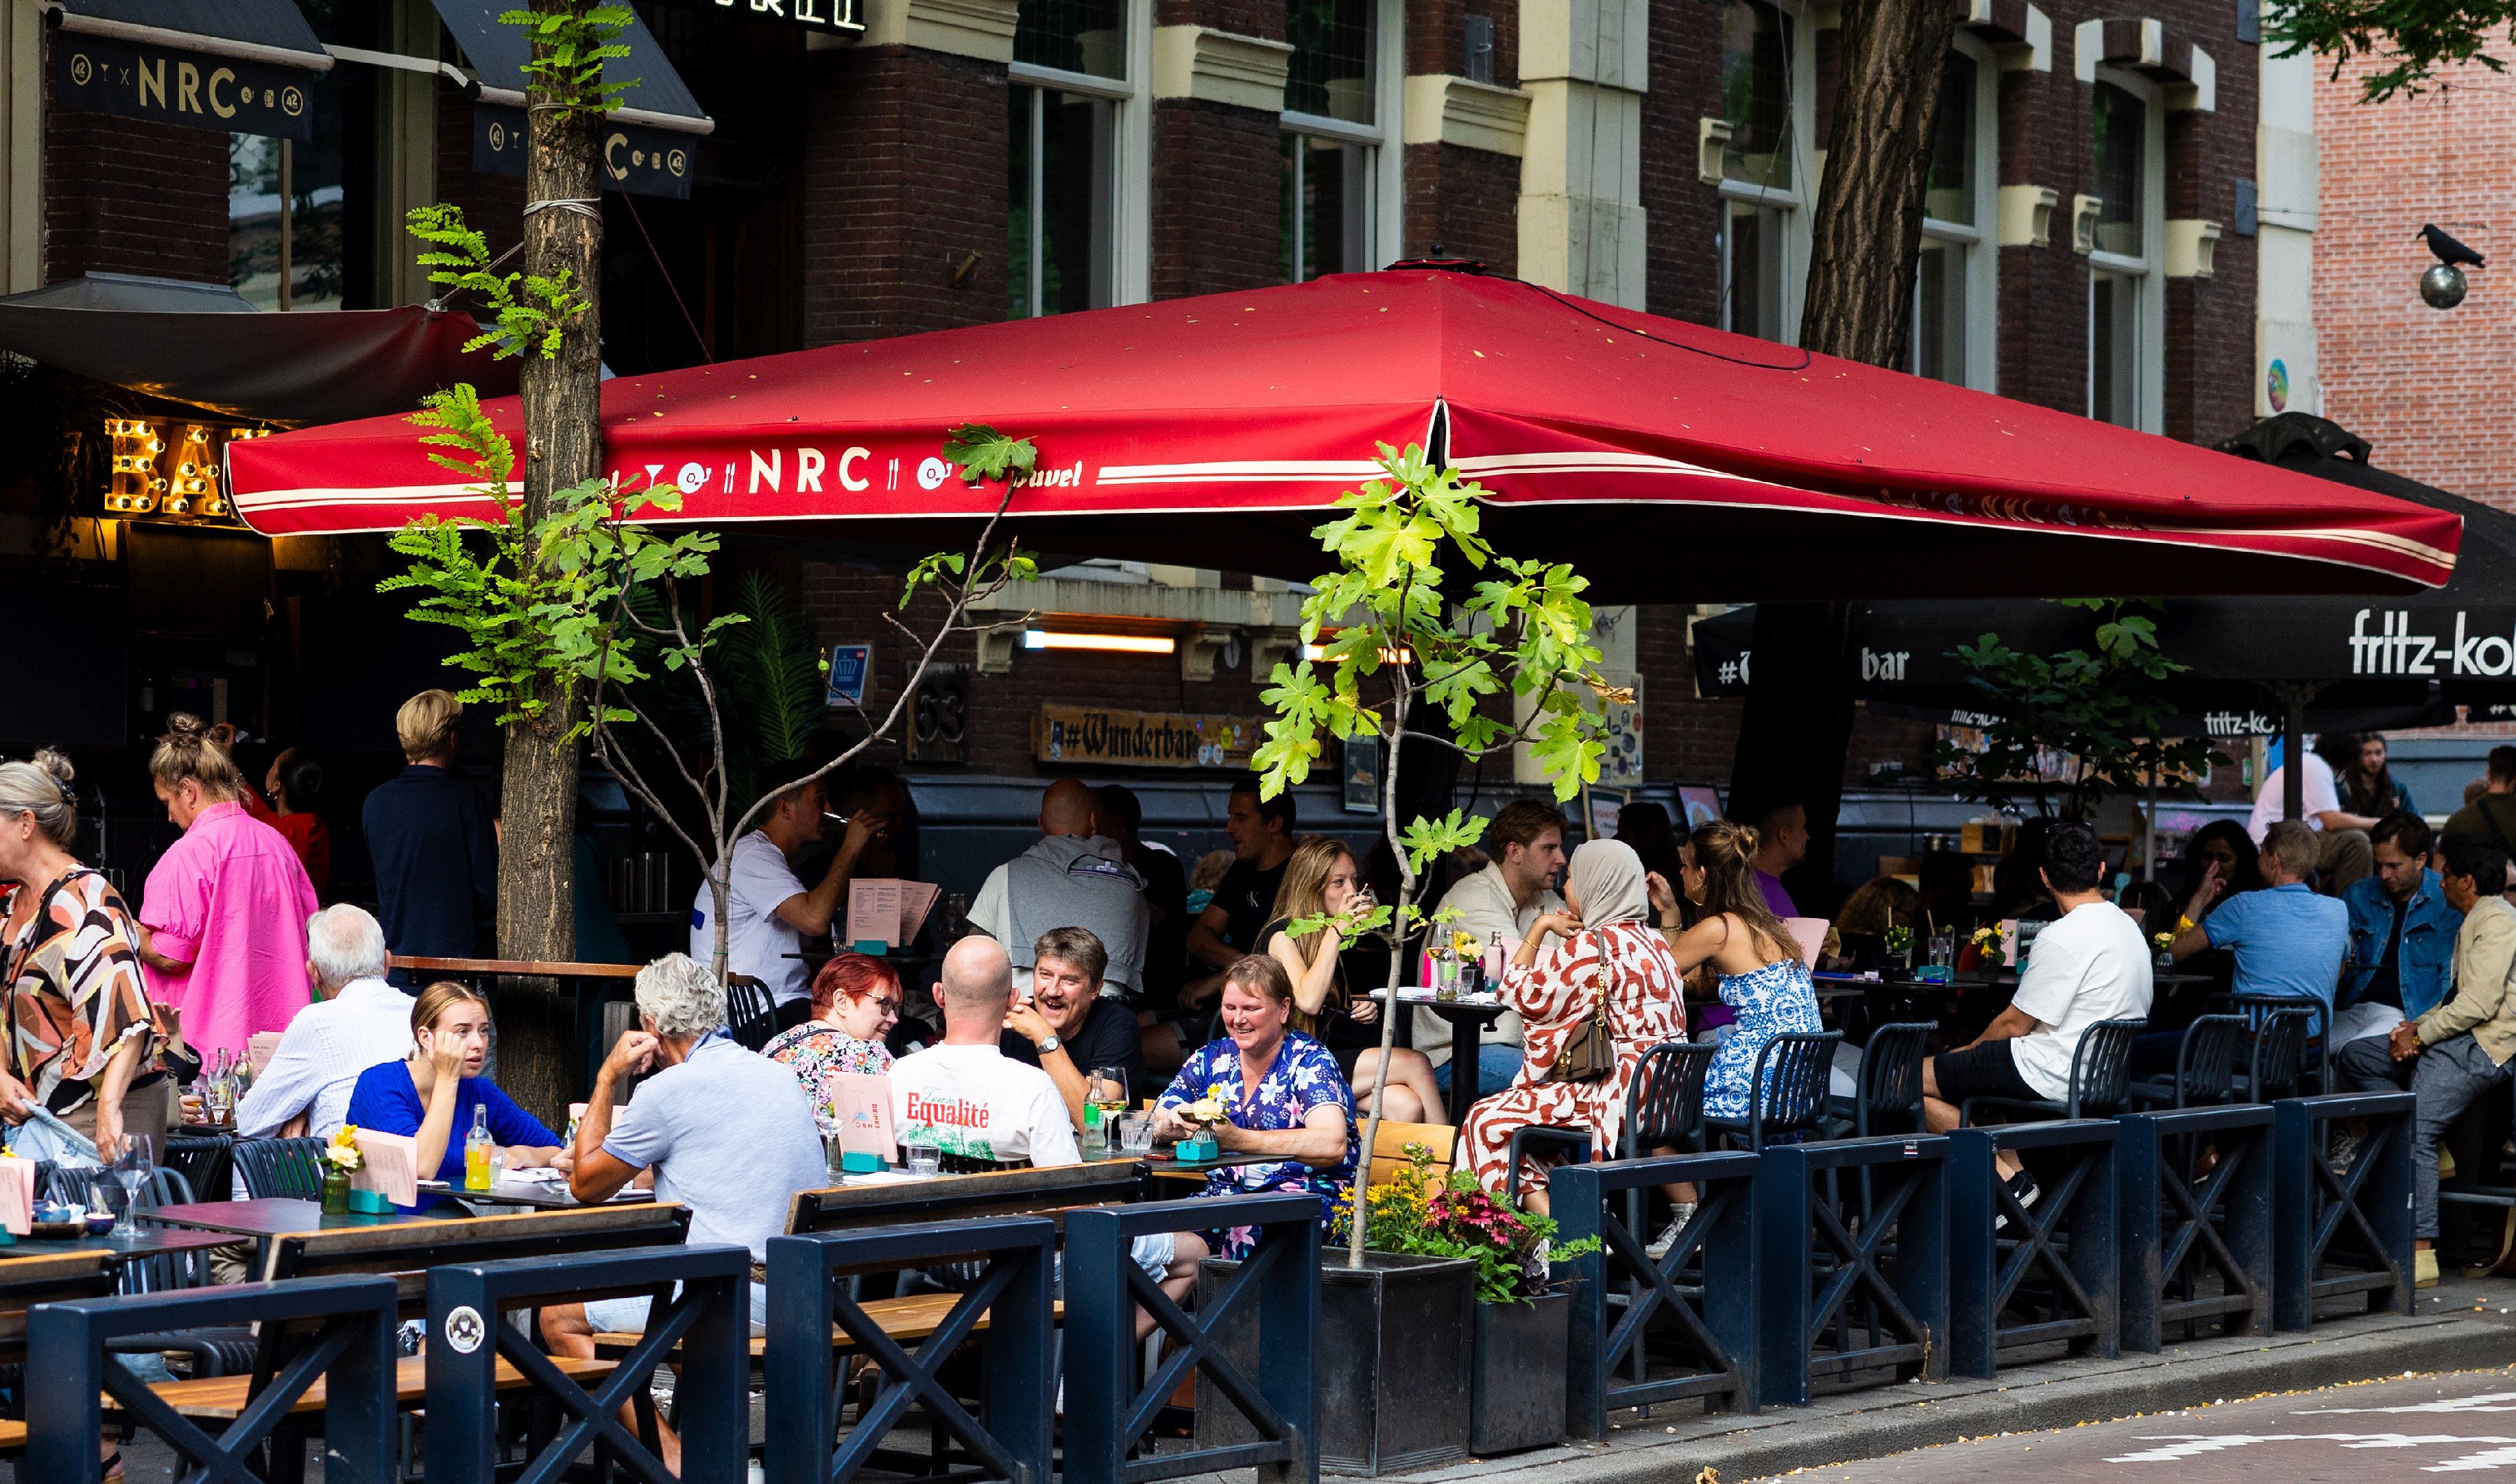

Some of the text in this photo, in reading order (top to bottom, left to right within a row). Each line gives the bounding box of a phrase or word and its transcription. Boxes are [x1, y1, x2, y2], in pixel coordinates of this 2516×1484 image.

[140, 55, 236, 119] NRC
[105, 419, 277, 516] BA
[749, 446, 871, 494] NRC
[1065, 713, 1193, 760] #Wunderbar
[872, 1104, 881, 1129] DRINKS
[907, 1092, 989, 1128] Equalité
[922, 1086, 956, 1105] Team
